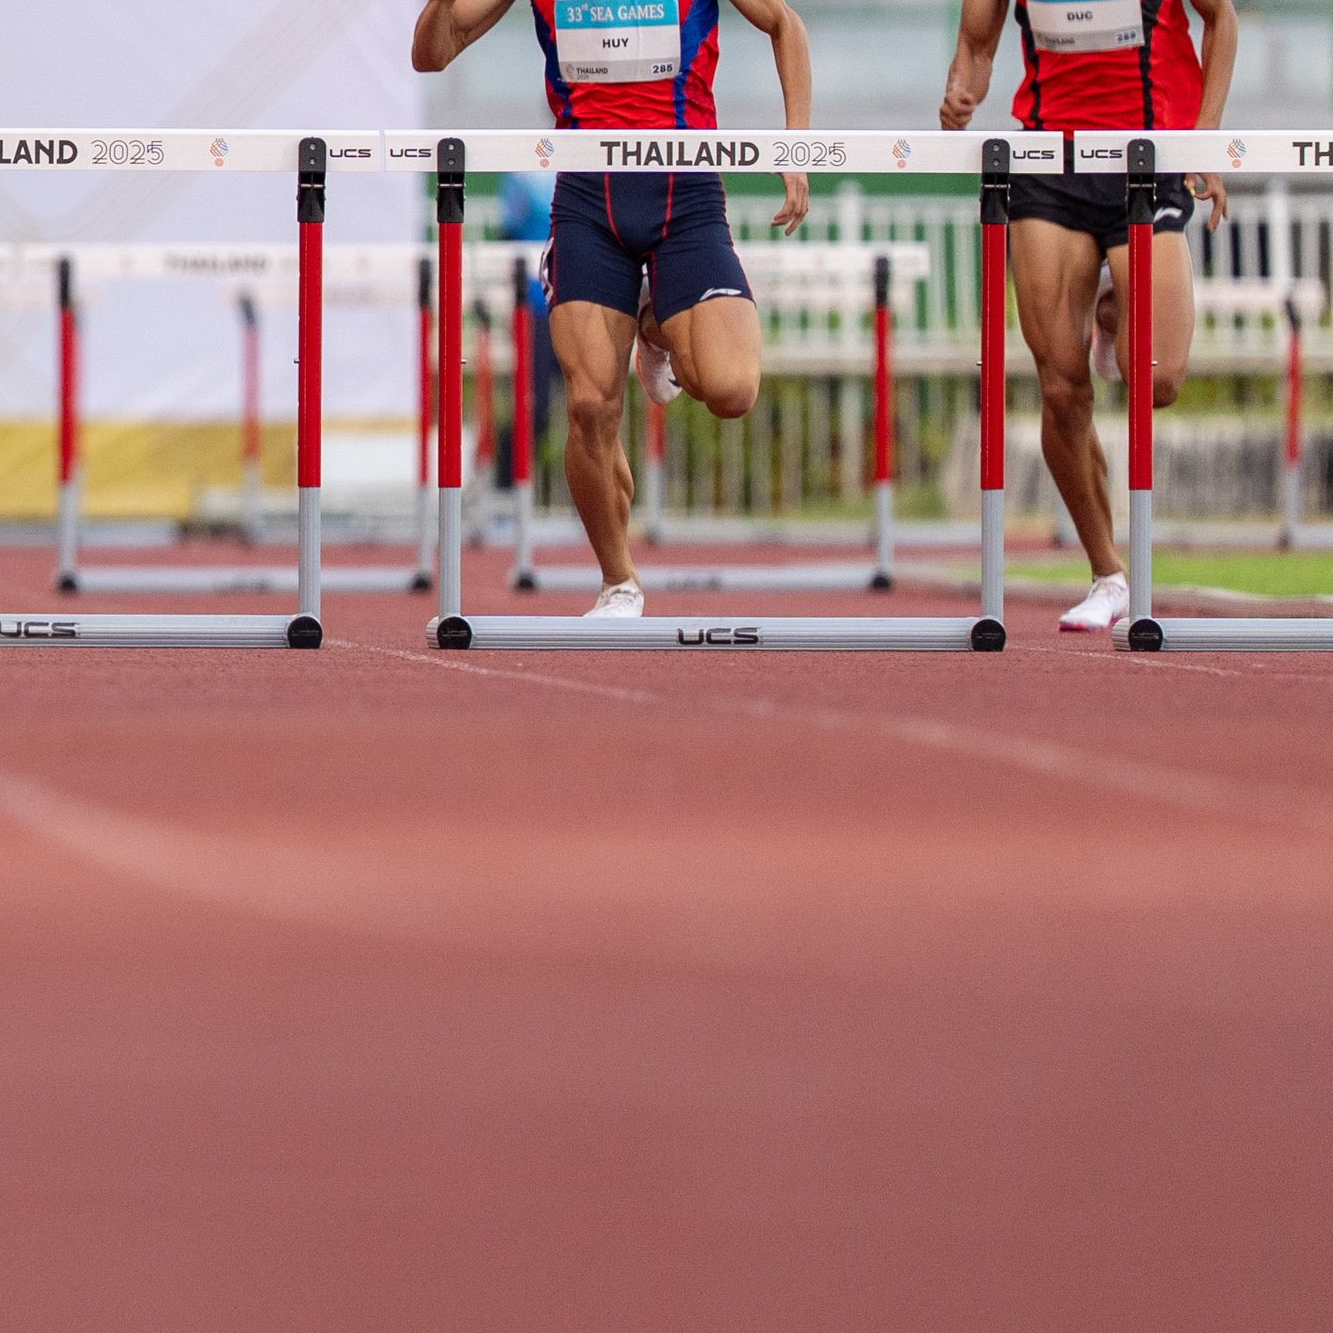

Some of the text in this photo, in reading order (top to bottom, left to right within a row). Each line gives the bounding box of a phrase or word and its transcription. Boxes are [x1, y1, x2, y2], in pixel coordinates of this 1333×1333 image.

[590, 6, 614, 21] SEA
[617, 4, 665, 20] GAMES
[602, 38, 629, 49] HUY
[576, 66, 609, 75] THAILAND
[652, 64, 673, 74] 285
[91, 139, 165, 165] 2025
[329, 148, 372, 158] UCS
[390, 148, 432, 158] UCS
[600, 141, 847, 167] THAILAND 2025
[1013, 150, 1055, 160] UCS
[1080, 149, 1123, 159] UCS
[677, 627, 759, 645] UCS
